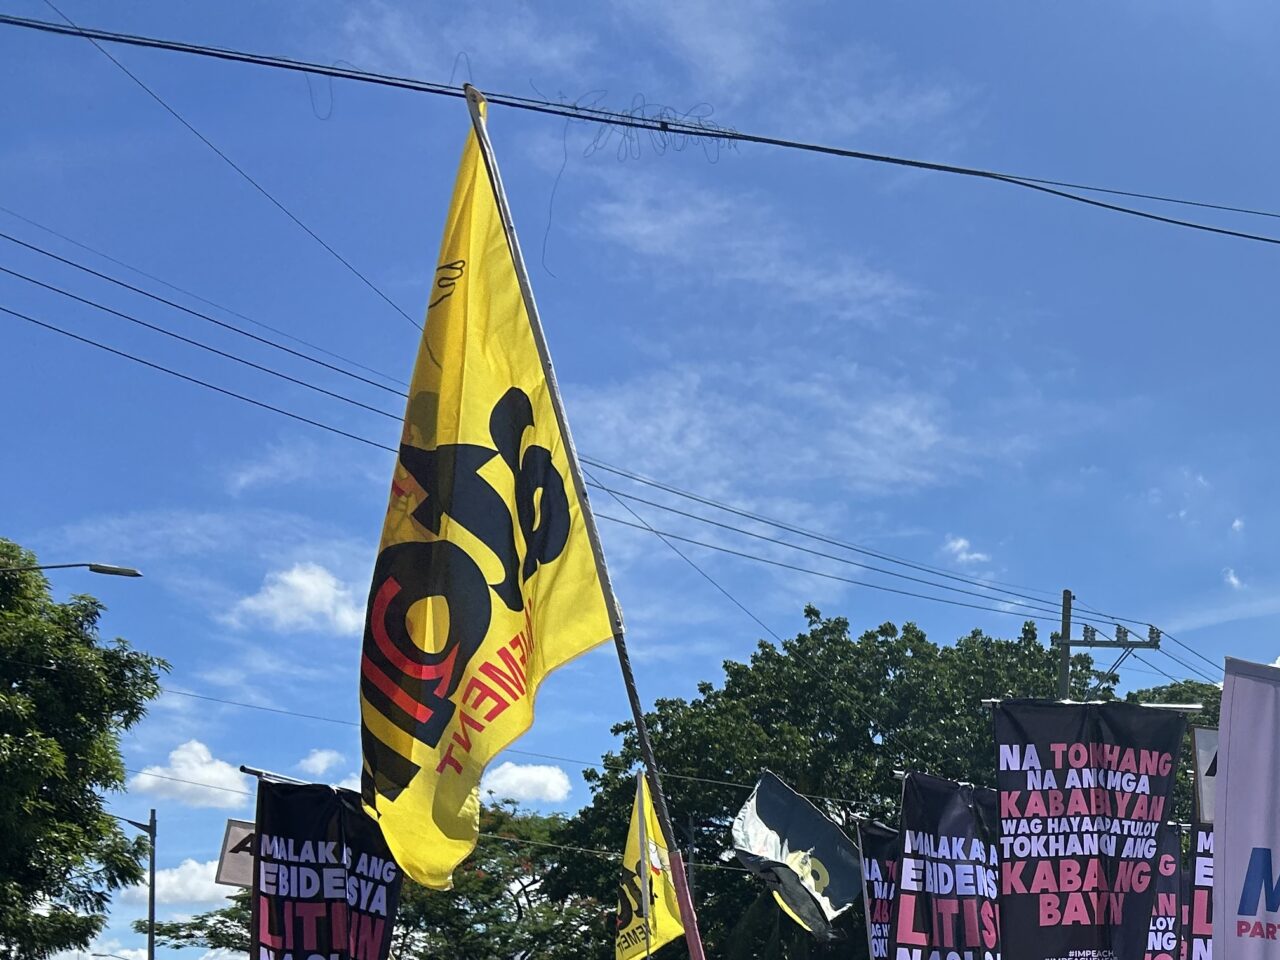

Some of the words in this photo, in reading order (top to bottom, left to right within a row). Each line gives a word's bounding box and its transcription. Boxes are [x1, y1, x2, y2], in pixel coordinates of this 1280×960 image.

[1000, 744, 1042, 771] NA
[1027, 768, 1058, 790] NA
[1106, 770, 1150, 794] MGA
[1002, 819, 1043, 835] WAG
[1121, 837, 1157, 859] ANG
[356, 852, 397, 883] ANG
[1002, 858, 1110, 895] KABA
[1114, 860, 1152, 893] NG
[260, 860, 388, 917] EBIDESYA
[1039, 892, 1125, 927] BAYN
